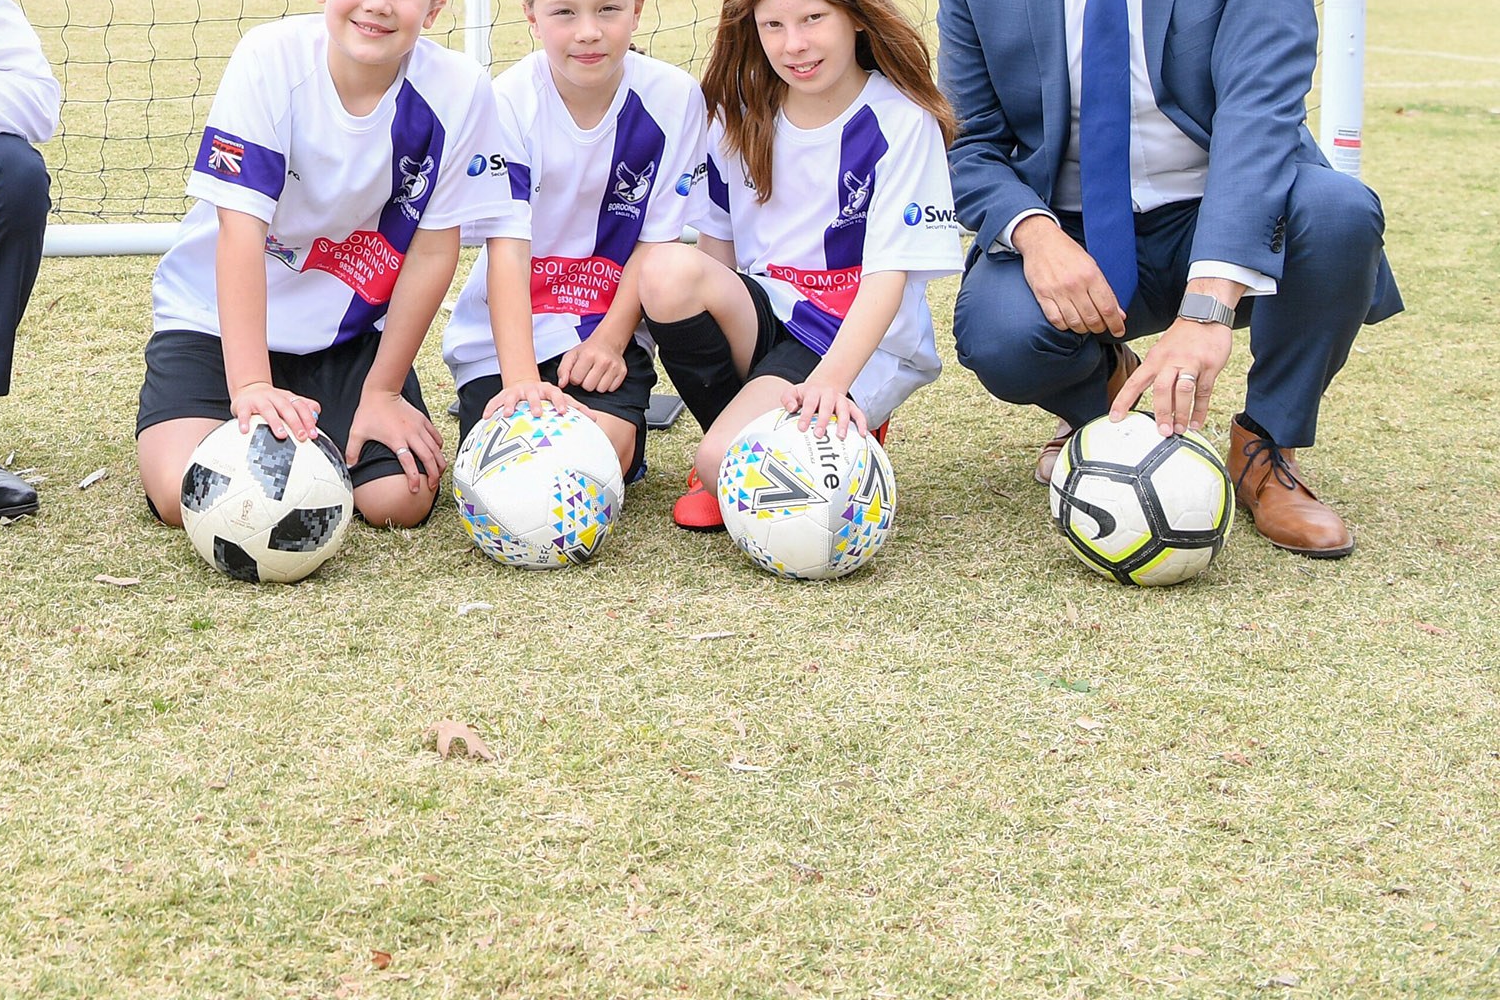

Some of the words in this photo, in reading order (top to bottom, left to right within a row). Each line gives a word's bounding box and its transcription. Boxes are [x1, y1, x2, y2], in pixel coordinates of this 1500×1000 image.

[318, 234, 400, 270] SOMONS
[334, 251, 374, 281] BALWYN
[533, 261, 621, 283] SOLOMONS
[545, 273, 610, 291] FLOORING
[551, 284, 598, 300] BALWYN
